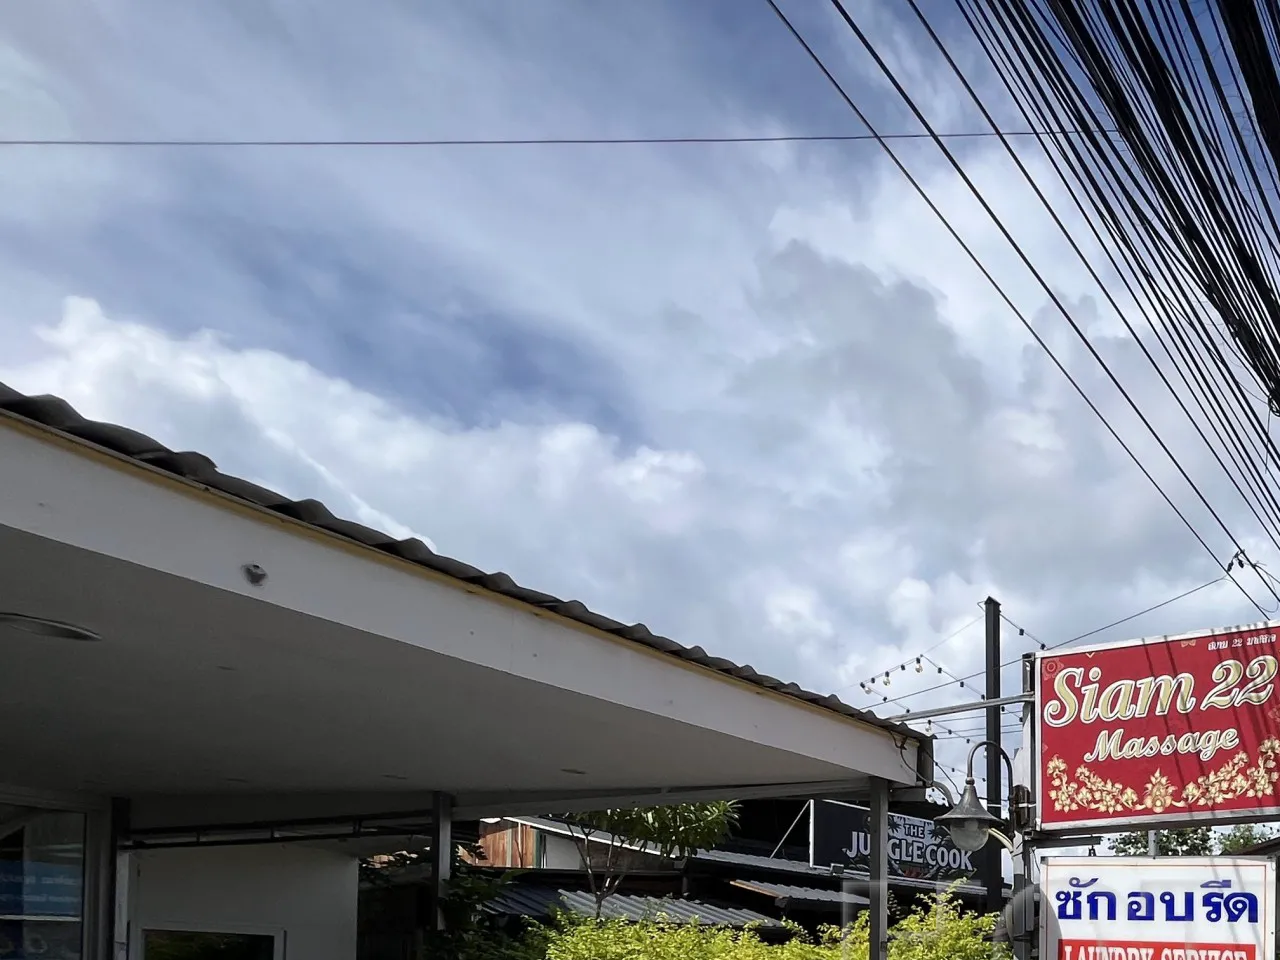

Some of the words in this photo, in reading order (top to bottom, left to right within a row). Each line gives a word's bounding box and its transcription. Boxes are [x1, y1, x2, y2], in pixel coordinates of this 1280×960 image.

[1232, 638, 1243, 648] 22
[1044, 667, 1196, 727] Siam
[1200, 655, 1278, 711] 22
[1084, 728, 1239, 762] Massage
[903, 824, 926, 838] THE
[846, 831, 924, 864] JUGLE
[926, 845, 974, 871] COOK
[1128, 891, 1194, 922] อบ
[1200, 879, 1259, 924] รีด
